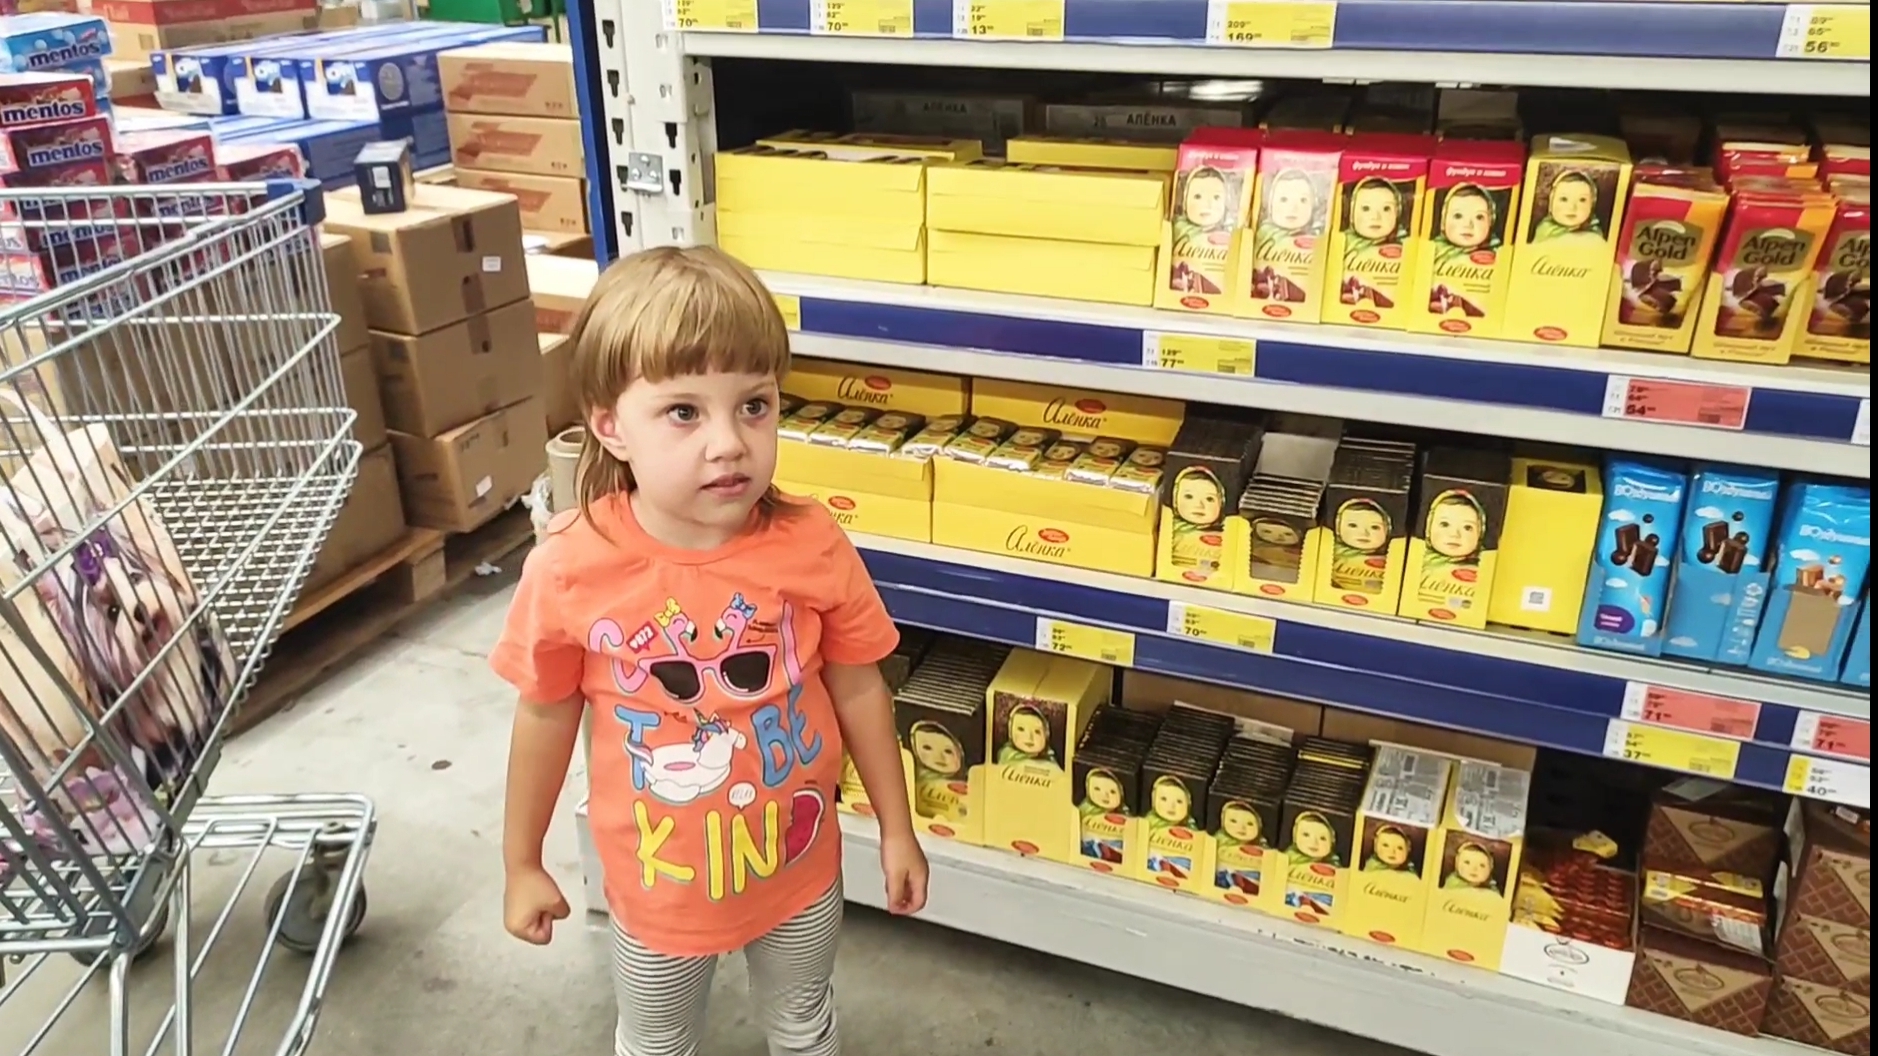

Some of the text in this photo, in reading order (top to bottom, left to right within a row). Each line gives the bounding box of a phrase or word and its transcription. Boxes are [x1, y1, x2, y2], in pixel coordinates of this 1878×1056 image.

[29, 42, 100, 67] mentos
[3, 101, 85, 123] mentos
[1126, 113, 1177, 127] АЛЁНКА
[30, 141, 103, 165] mentos
[149, 159, 208, 182] mentos
[1636, 226, 1696, 247] Alpen
[1742, 236, 1806, 253] Alpen
[1638, 243, 1688, 261] Gold
[1743, 249, 1797, 266] Gold
[1839, 250, 1870, 268] Go
[750, 683, 822, 788] BE
